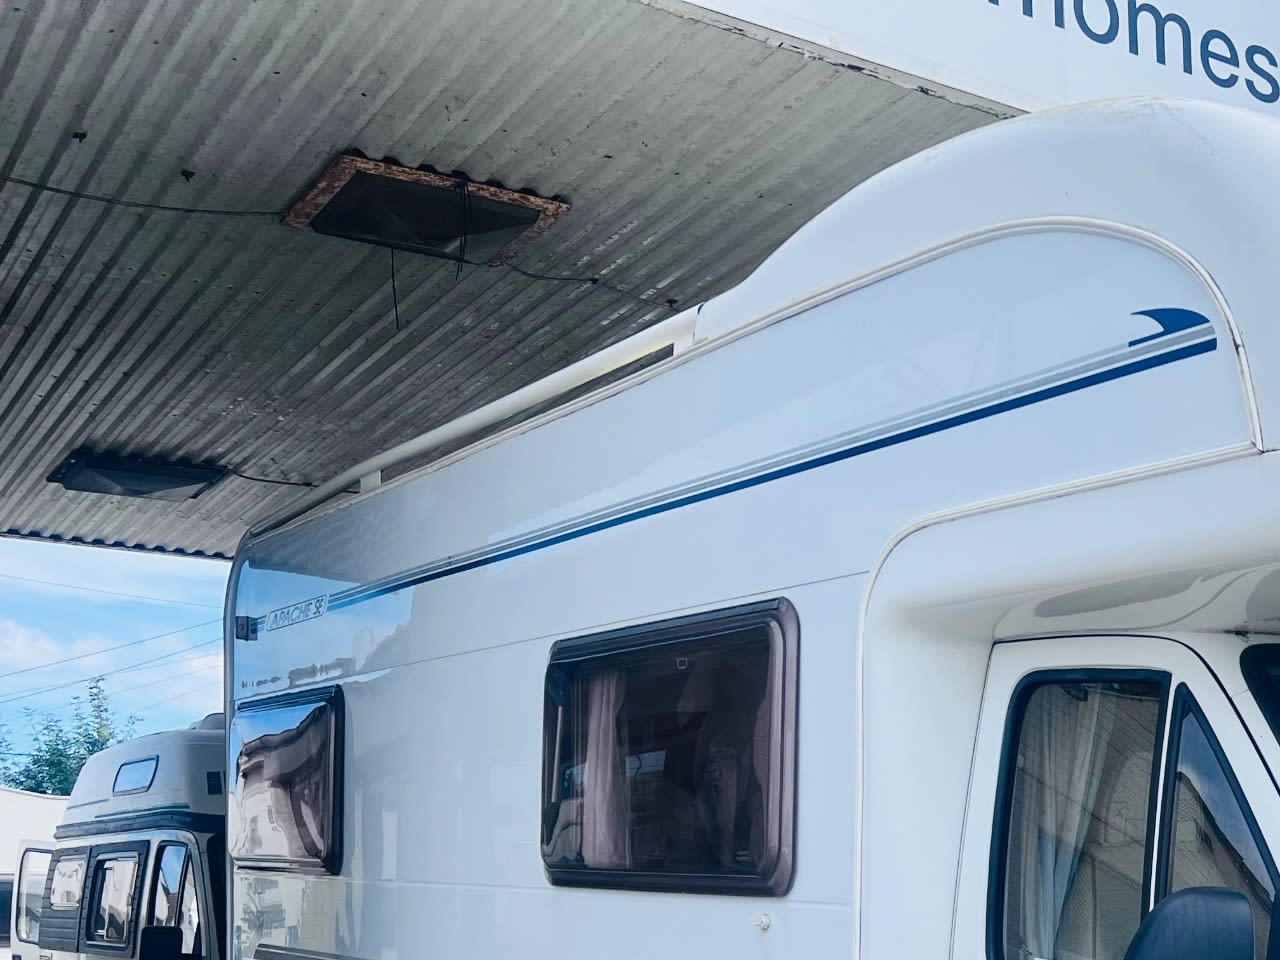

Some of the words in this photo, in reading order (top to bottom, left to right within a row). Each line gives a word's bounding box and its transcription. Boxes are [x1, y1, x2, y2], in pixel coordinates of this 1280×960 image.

[988, 0, 1280, 103] omes
[270, 602, 312, 628] APACHE
[313, 598, 324, 615] SE
